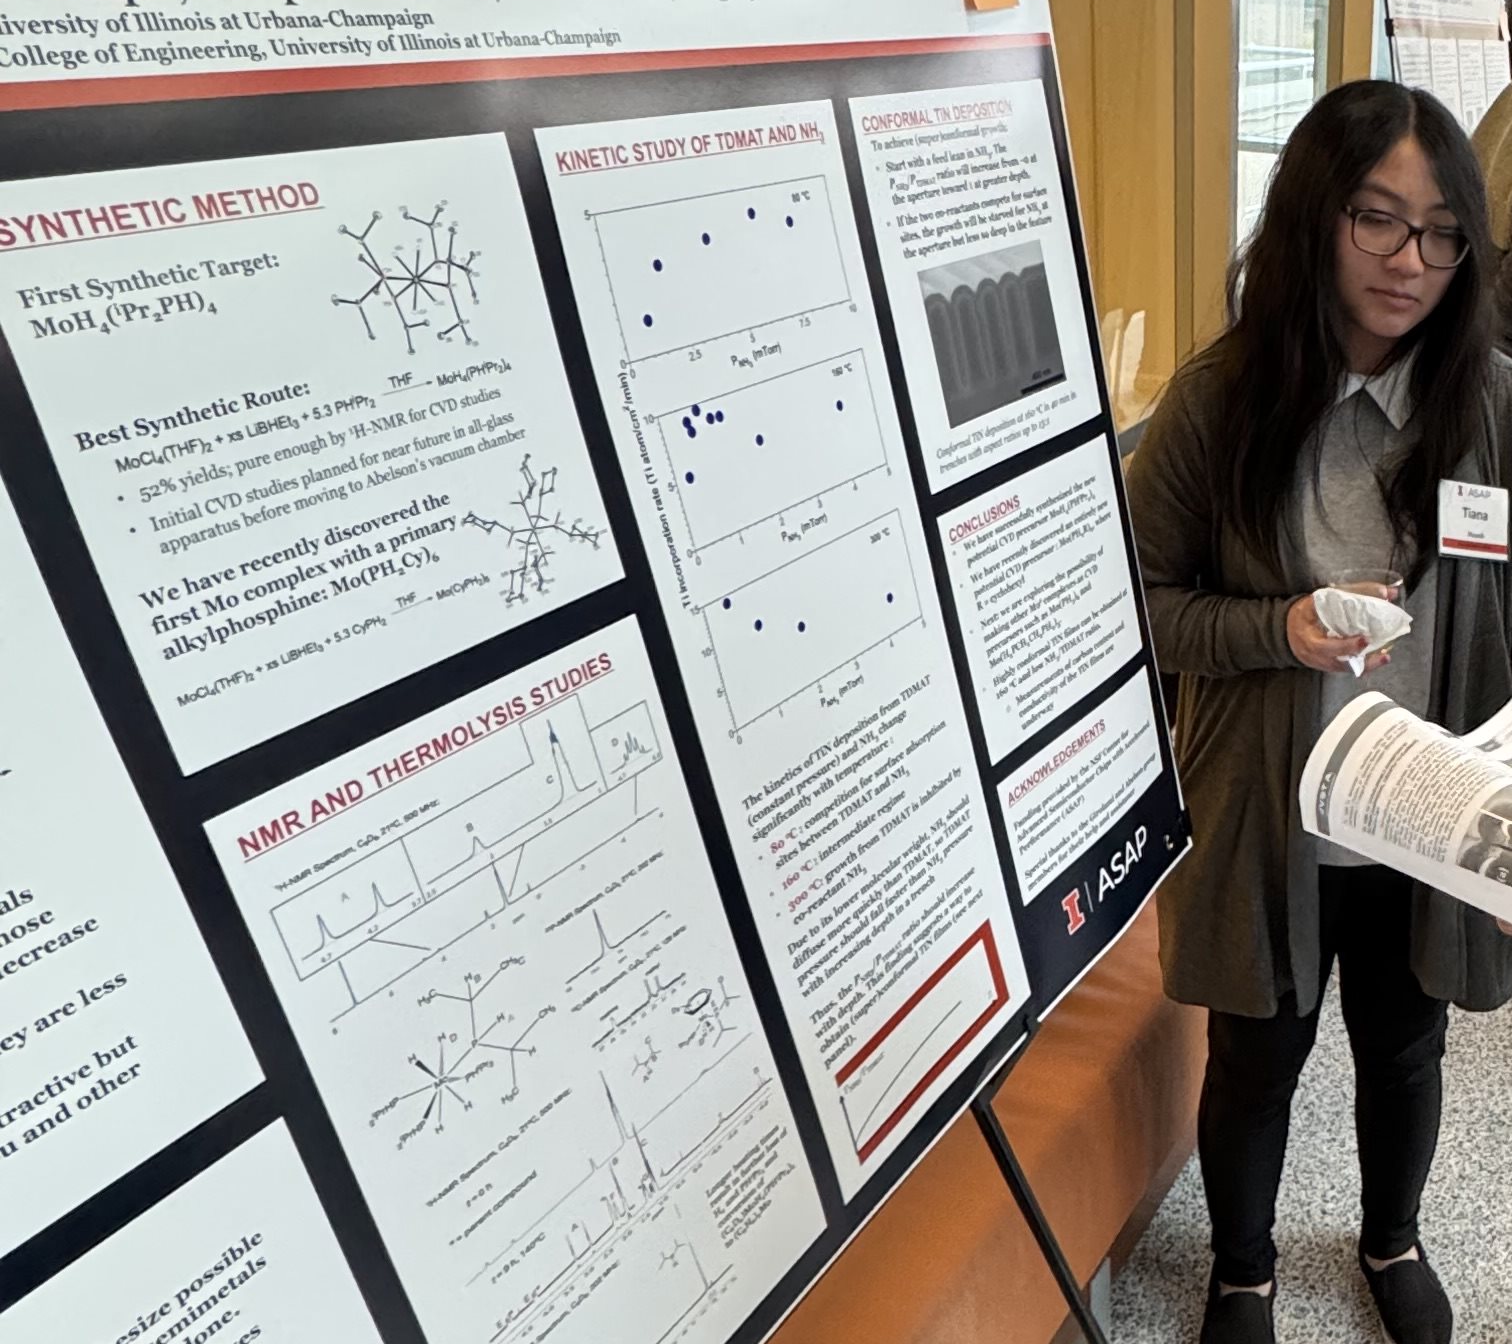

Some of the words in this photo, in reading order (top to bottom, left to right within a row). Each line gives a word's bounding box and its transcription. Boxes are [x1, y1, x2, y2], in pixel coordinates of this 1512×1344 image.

[0, 13, 99, 38] iversity
[106, 13, 129, 34] of
[133, 12, 217, 33] Illinois
[221, 13, 243, 31] at
[243, 8, 434, 30] Urbana-Champaign
[0, 44, 91, 70] College
[95, 43, 121, 64] of
[121, 39, 268, 62] Engineering,
[269, 36, 373, 58] University
[376, 34, 398, 53] of
[400, 31, 461, 51] Illinois
[464, 35, 482, 49] at
[484, 27, 622, 50] Urbana-Champaign
[556, 144, 629, 173] KINETIC
[632, 137, 686, 163] STUDY
[691, 134, 712, 155] OF
[714, 128, 764, 152] TDMAT
[769, 123, 797, 144] AND
[862, 109, 934, 133] CONFORMAL
[0, 197, 187, 246] SYNTHETIC
[191, 181, 320, 221] METHOD
[15, 283, 85, 310] First
[84, 263, 201, 301] Synthetic
[198, 252, 280, 279] Target:
[72, 424, 133, 453] Best
[132, 397, 241, 439] Synthetic
[240, 382, 311, 411] Route:
[138, 476, 178, 504] 52%
[177, 463, 234, 493] yields;
[233, 453, 272, 478] pure
[273, 434, 329, 462] enough
[326, 430, 347, 448] by
[407, 407, 428, 424] for
[428, 397, 458, 417] CVD
[459, 387, 502, 409] studies
[148, 501, 204, 533] Initial
[204, 492, 243, 515] CVD
[244, 477, 300, 504] studies
[299, 455, 360, 491] planned
[358, 452, 380, 469] for
[381, 442, 412, 462] near
[411, 431, 453, 452] future
[451, 425, 467, 441] in
[467, 412, 515, 436] all-glass
[159, 518, 242, 556] apparatus
[239, 503, 292, 528] before
[292, 484, 349, 511] moving
[347, 480, 364, 494] to
[427, 444, 477, 468] vacuum
[477, 428, 526, 453] chamber
[137, 585, 182, 609] We
[180, 567, 237, 596] have
[237, 536, 320, 577] recently
[323, 499, 422, 547] discovered
[421, 493, 451, 512] the
[949, 494, 1021, 543] CONCLUSIONS
[150, 605, 203, 636] first
[200, 594, 241, 617] Mo
[242, 561, 329, 602] complex
[328, 543, 374, 570] with
[373, 541, 388, 555] a
[387, 514, 457, 554] primary
[161, 588, 329, 661] alkylphosphine:
[237, 810, 305, 859] NMR
[309, 779, 365, 824] AND
[367, 696, 528, 789] THERMOLYSIS
[529, 652, 613, 707] STUDIES
[1008, 719, 1107, 806] ACKNOWLEDGEMENTS
[1098, 825, 1148, 903] ASAP
[0, 918, 100, 981] ecrease
[35, 1001, 77, 1033] are
[77, 973, 129, 1009] less
[94, 1033, 139, 1069] but
[24, 1103, 73, 1145] and
[76, 1061, 142, 1111] other
[173, 1232, 263, 1309] possible
